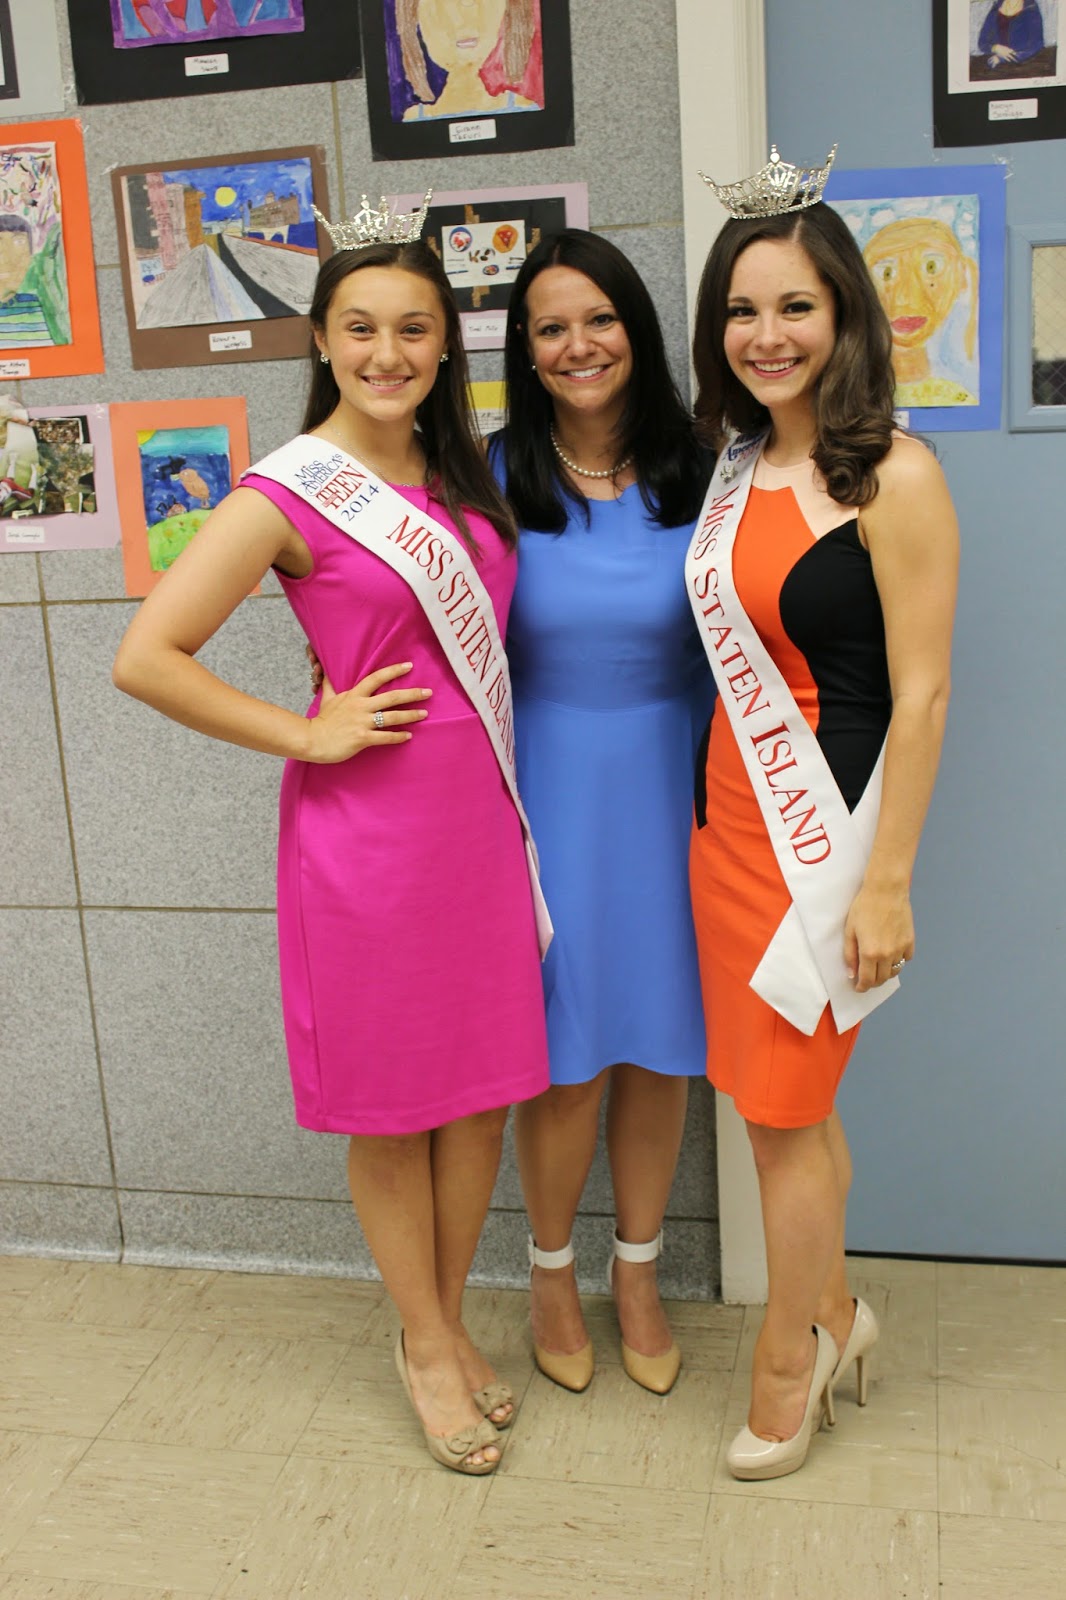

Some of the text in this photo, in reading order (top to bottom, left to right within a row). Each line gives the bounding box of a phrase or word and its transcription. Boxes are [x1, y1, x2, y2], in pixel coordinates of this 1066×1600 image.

[315, 463, 368, 510] TEEN
[341, 484, 380, 522] 2014
[385, 514, 454, 581] MISS
[438, 570, 497, 685] STATEN
[693, 485, 832, 865] MISS STATEN ISLAND
